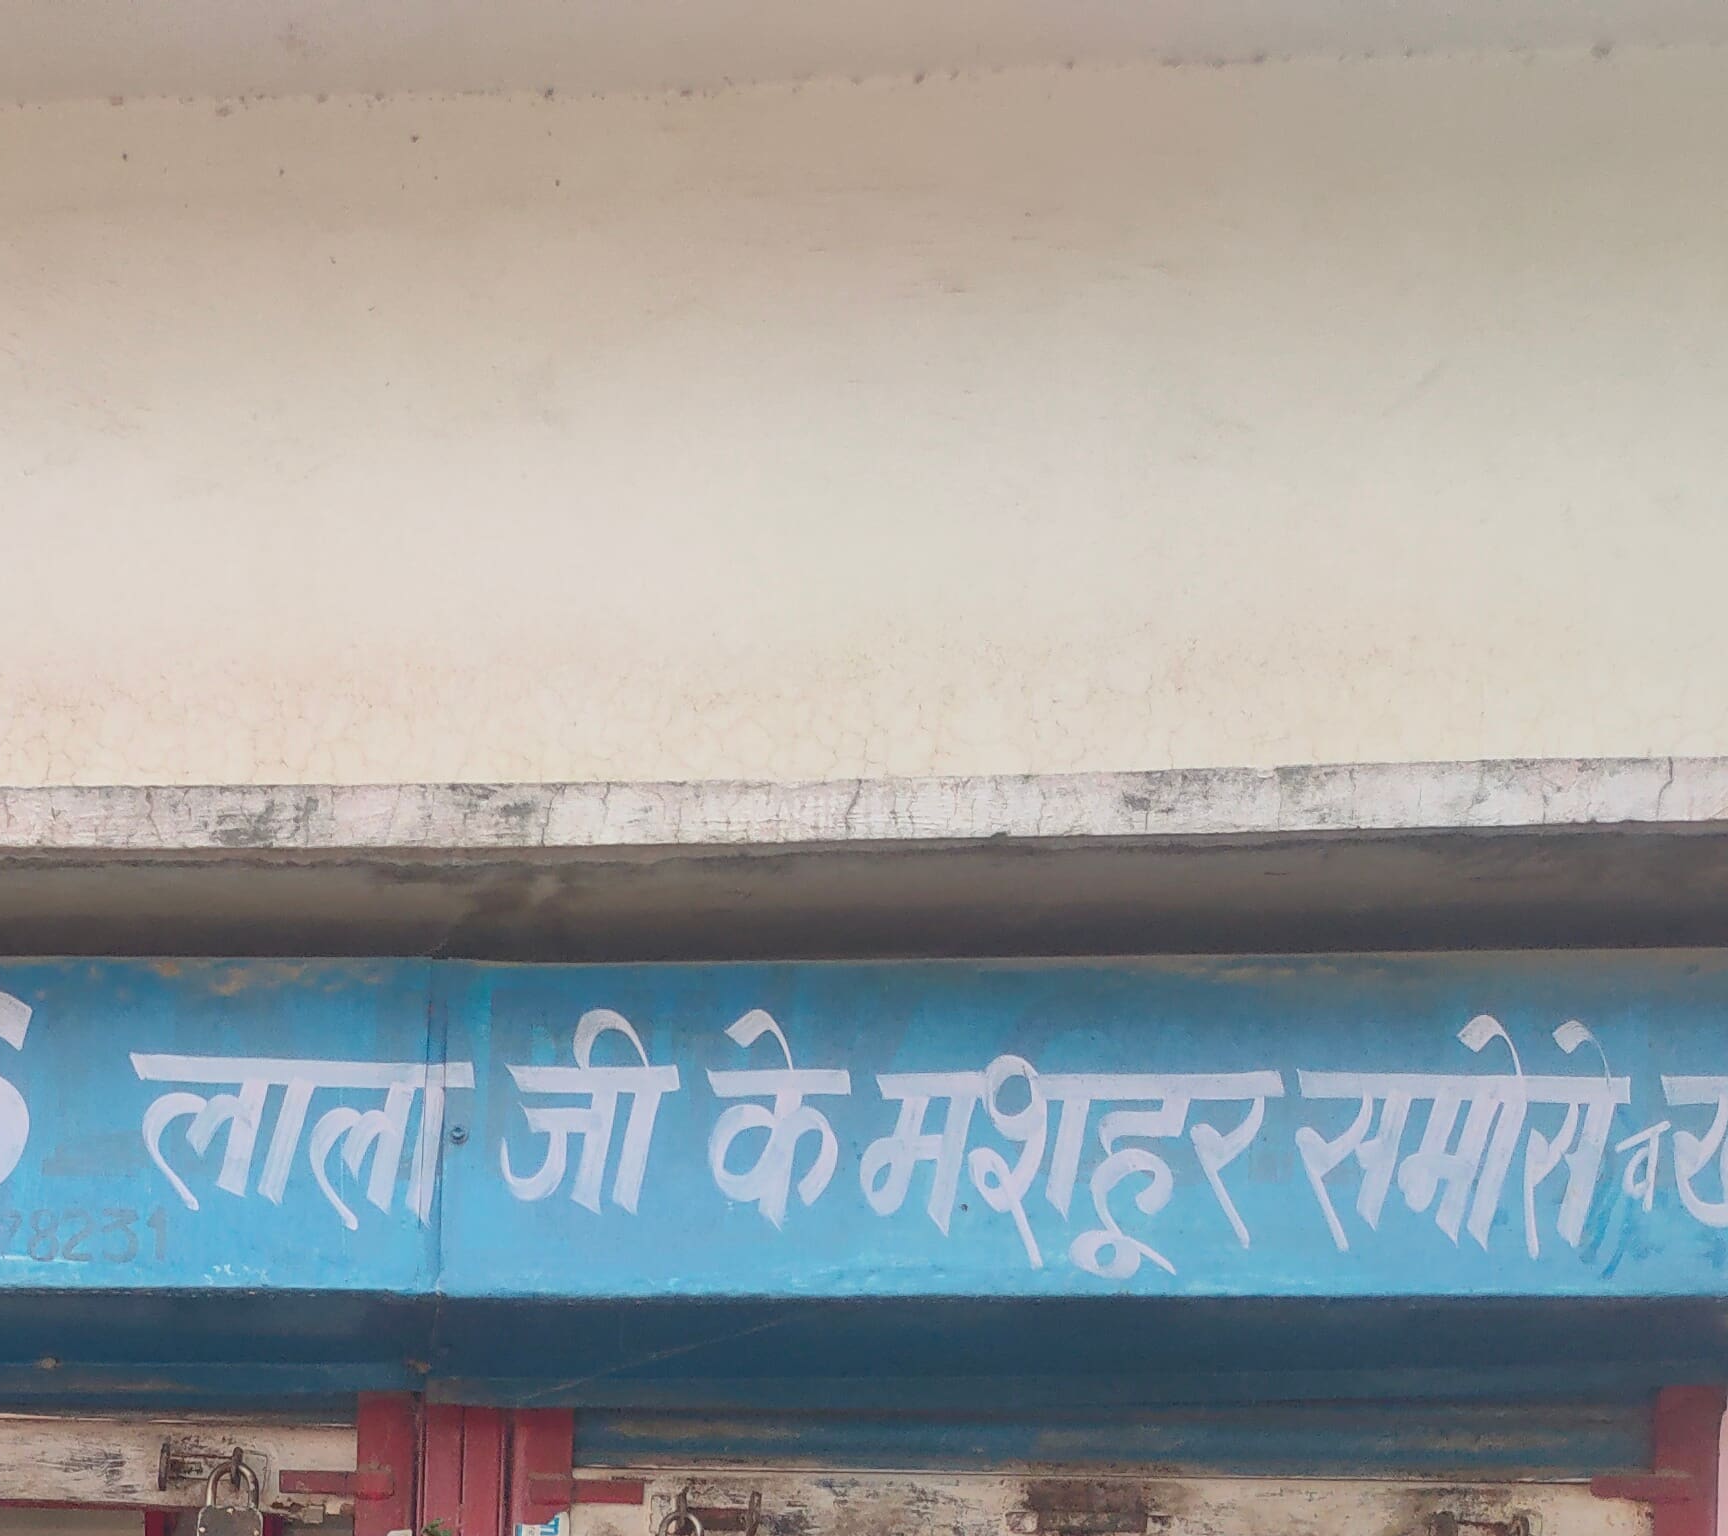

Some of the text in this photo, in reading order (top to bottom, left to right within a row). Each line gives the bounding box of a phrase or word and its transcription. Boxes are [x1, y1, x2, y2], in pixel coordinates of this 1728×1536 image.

[128, 1053, 474, 1231] लाला
[506, 1008, 680, 1214] जी
[706, 1008, 851, 1231] के
[860, 1054, 1284, 1281] मशहूर
